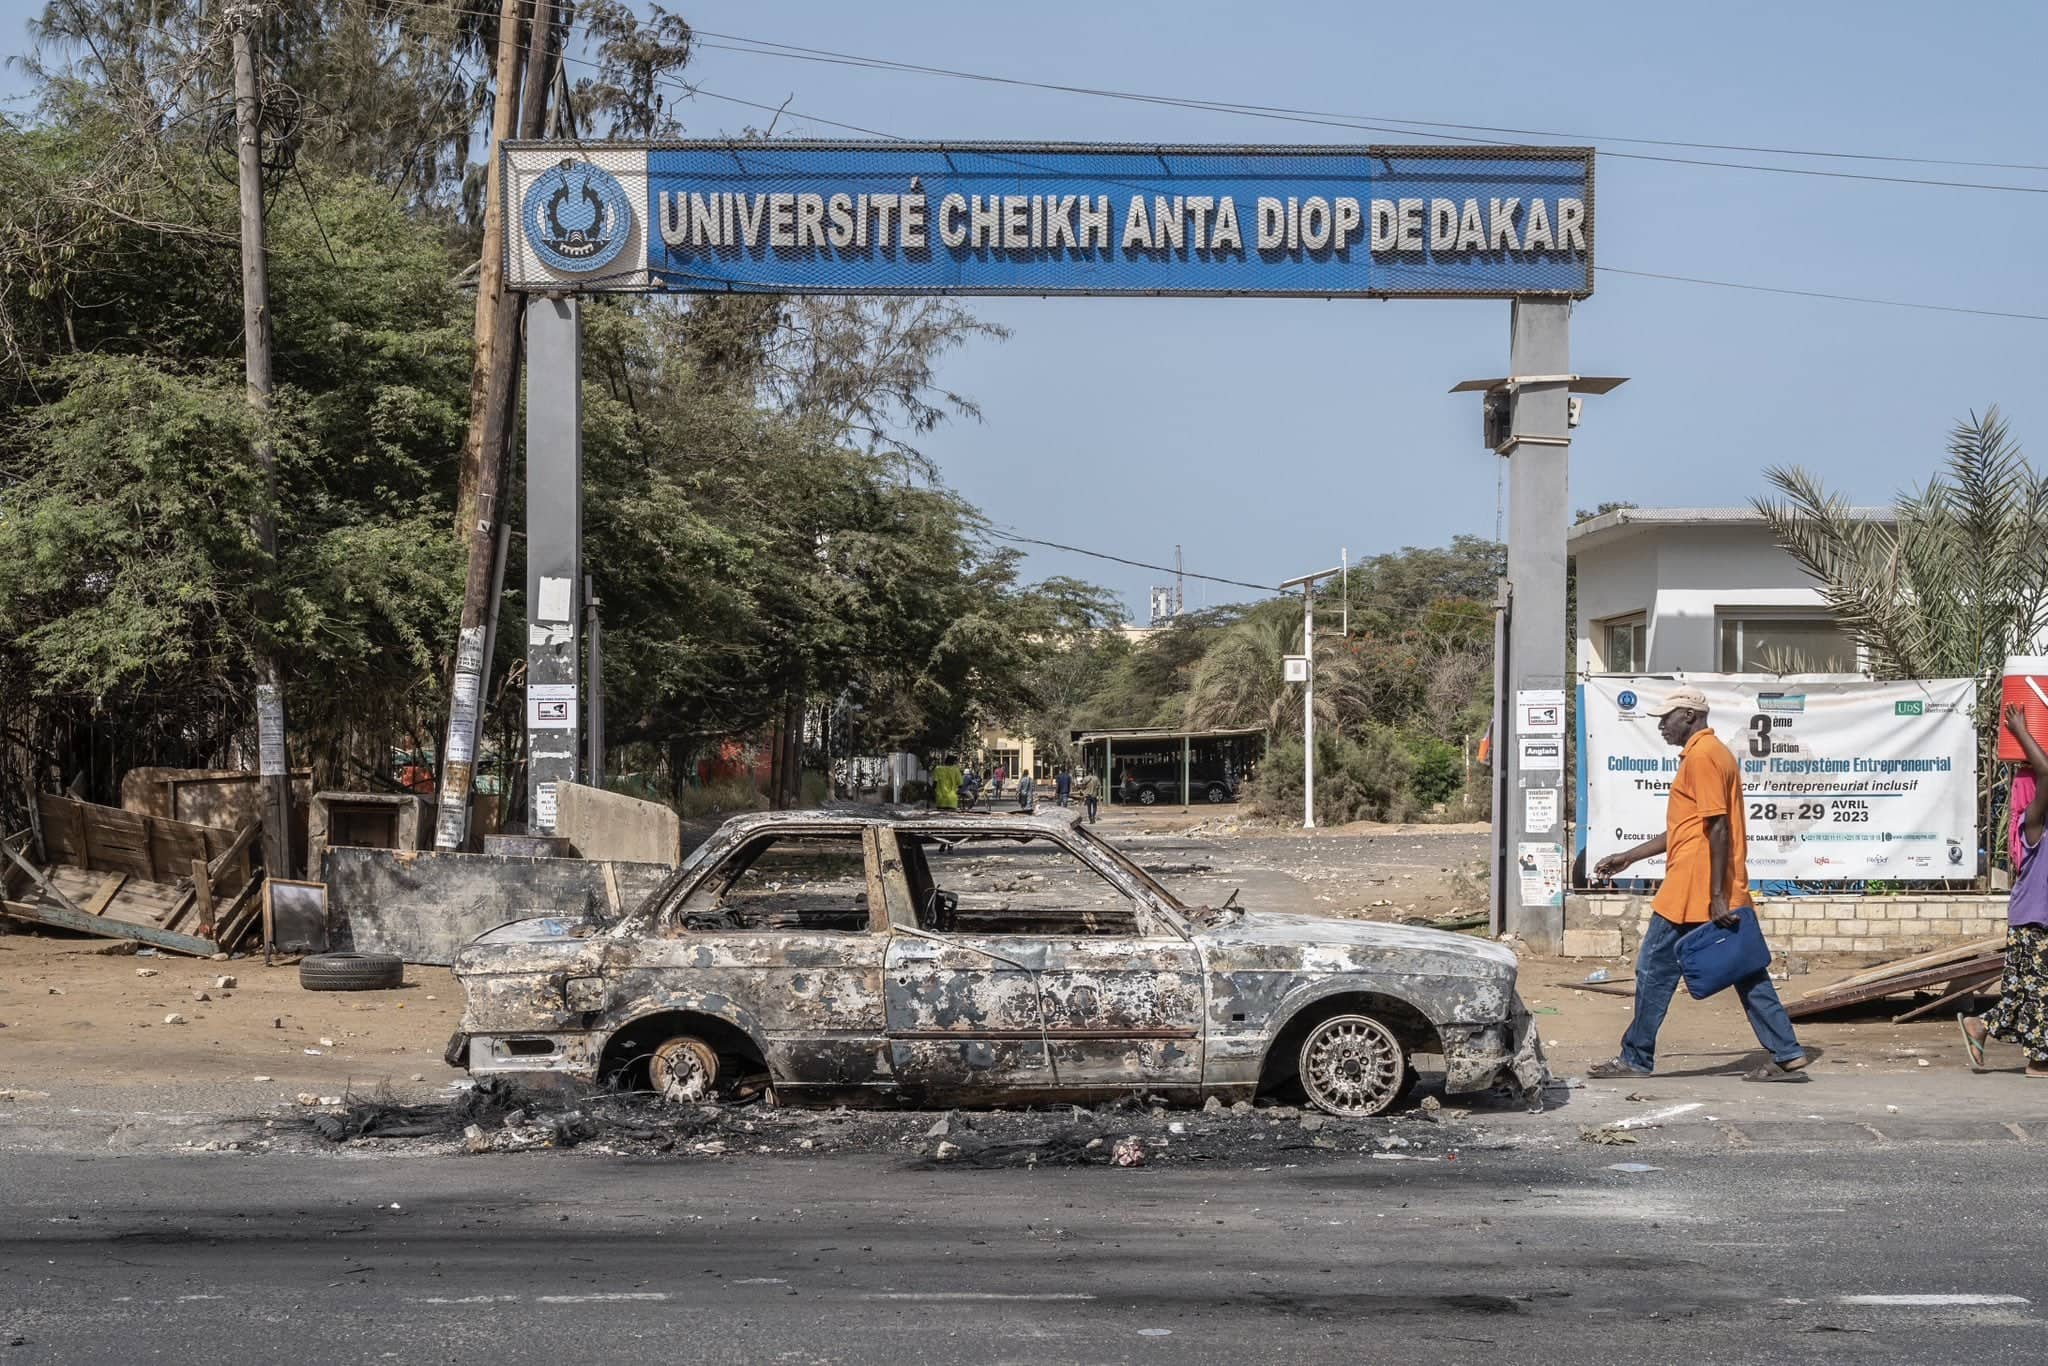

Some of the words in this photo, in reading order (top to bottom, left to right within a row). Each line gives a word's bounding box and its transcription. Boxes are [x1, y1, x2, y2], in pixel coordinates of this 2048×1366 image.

[658, 176, 928, 251] UNIVERSITÉ
[938, 193, 1109, 250] CHEIKH
[1121, 194, 1243, 251] ANTA
[1256, 195, 1362, 252] DIOP
[1369, 197, 1424, 253] DE
[1428, 197, 1587, 252] DAKAR
[1749, 714, 1772, 757] 3
[1773, 715, 1793, 728] ème
[1772, 742, 1800, 753] Edition
[1607, 755, 1658, 774] Colloque
[1745, 759, 1766, 773] sur
[1853, 755, 1951, 775] Entrepreneurial
[1634, 779, 1673, 791] Thèm
[1742, 783, 1760, 791] cer
[1763, 780, 1869, 793] l'entrepreneuriat
[1871, 779, 1918, 791] inclusif
[1749, 803, 1778, 820] 28
[1781, 811, 1795, 820] ET
[1798, 803, 1825, 820] 29
[1831, 800, 1869, 810] AVRIL
[1833, 811, 1869, 822] 2023
[1623, 833, 1645, 841] ECOLE
[1756, 834, 1778, 842] DAKAR
